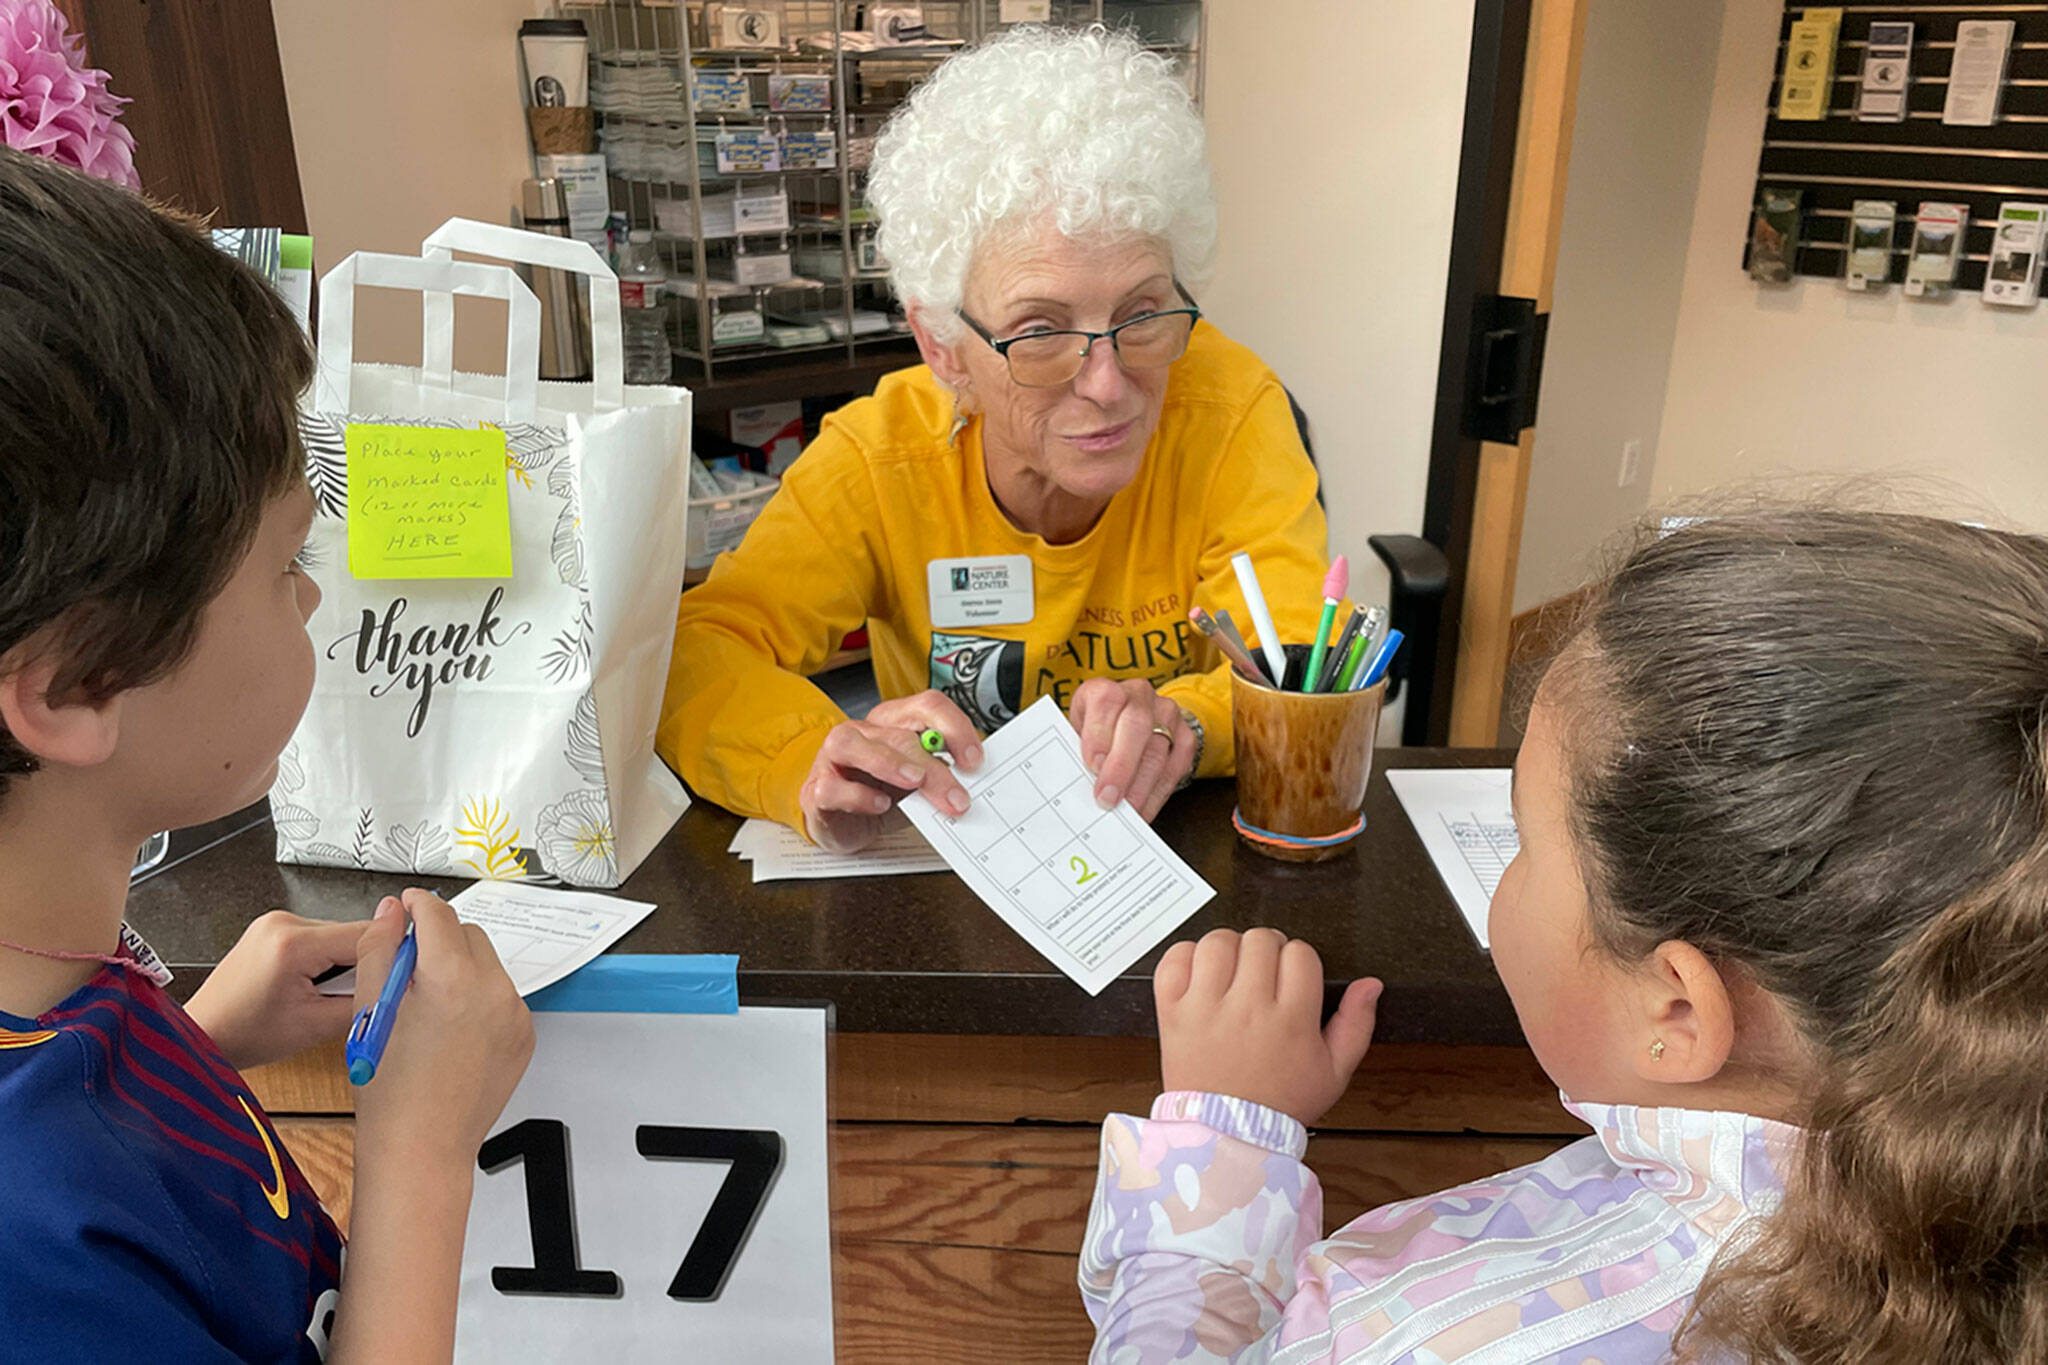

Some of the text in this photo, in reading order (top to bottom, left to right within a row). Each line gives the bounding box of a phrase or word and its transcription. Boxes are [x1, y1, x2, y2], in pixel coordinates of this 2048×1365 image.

[362, 442, 481, 463] Place your
[402, 501, 419, 509] or
[427, 501, 483, 510] more
[386, 533, 460, 551] HERE
[971, 570, 1009, 580] NATURE
[972, 580, 1009, 590] CENTER
[1131, 593, 1181, 627] RIVER
[327, 586, 532, 675] thank
[370, 653, 495, 738] you
[1070, 855, 1099, 885] 2
[477, 1117, 783, 1301] 17
